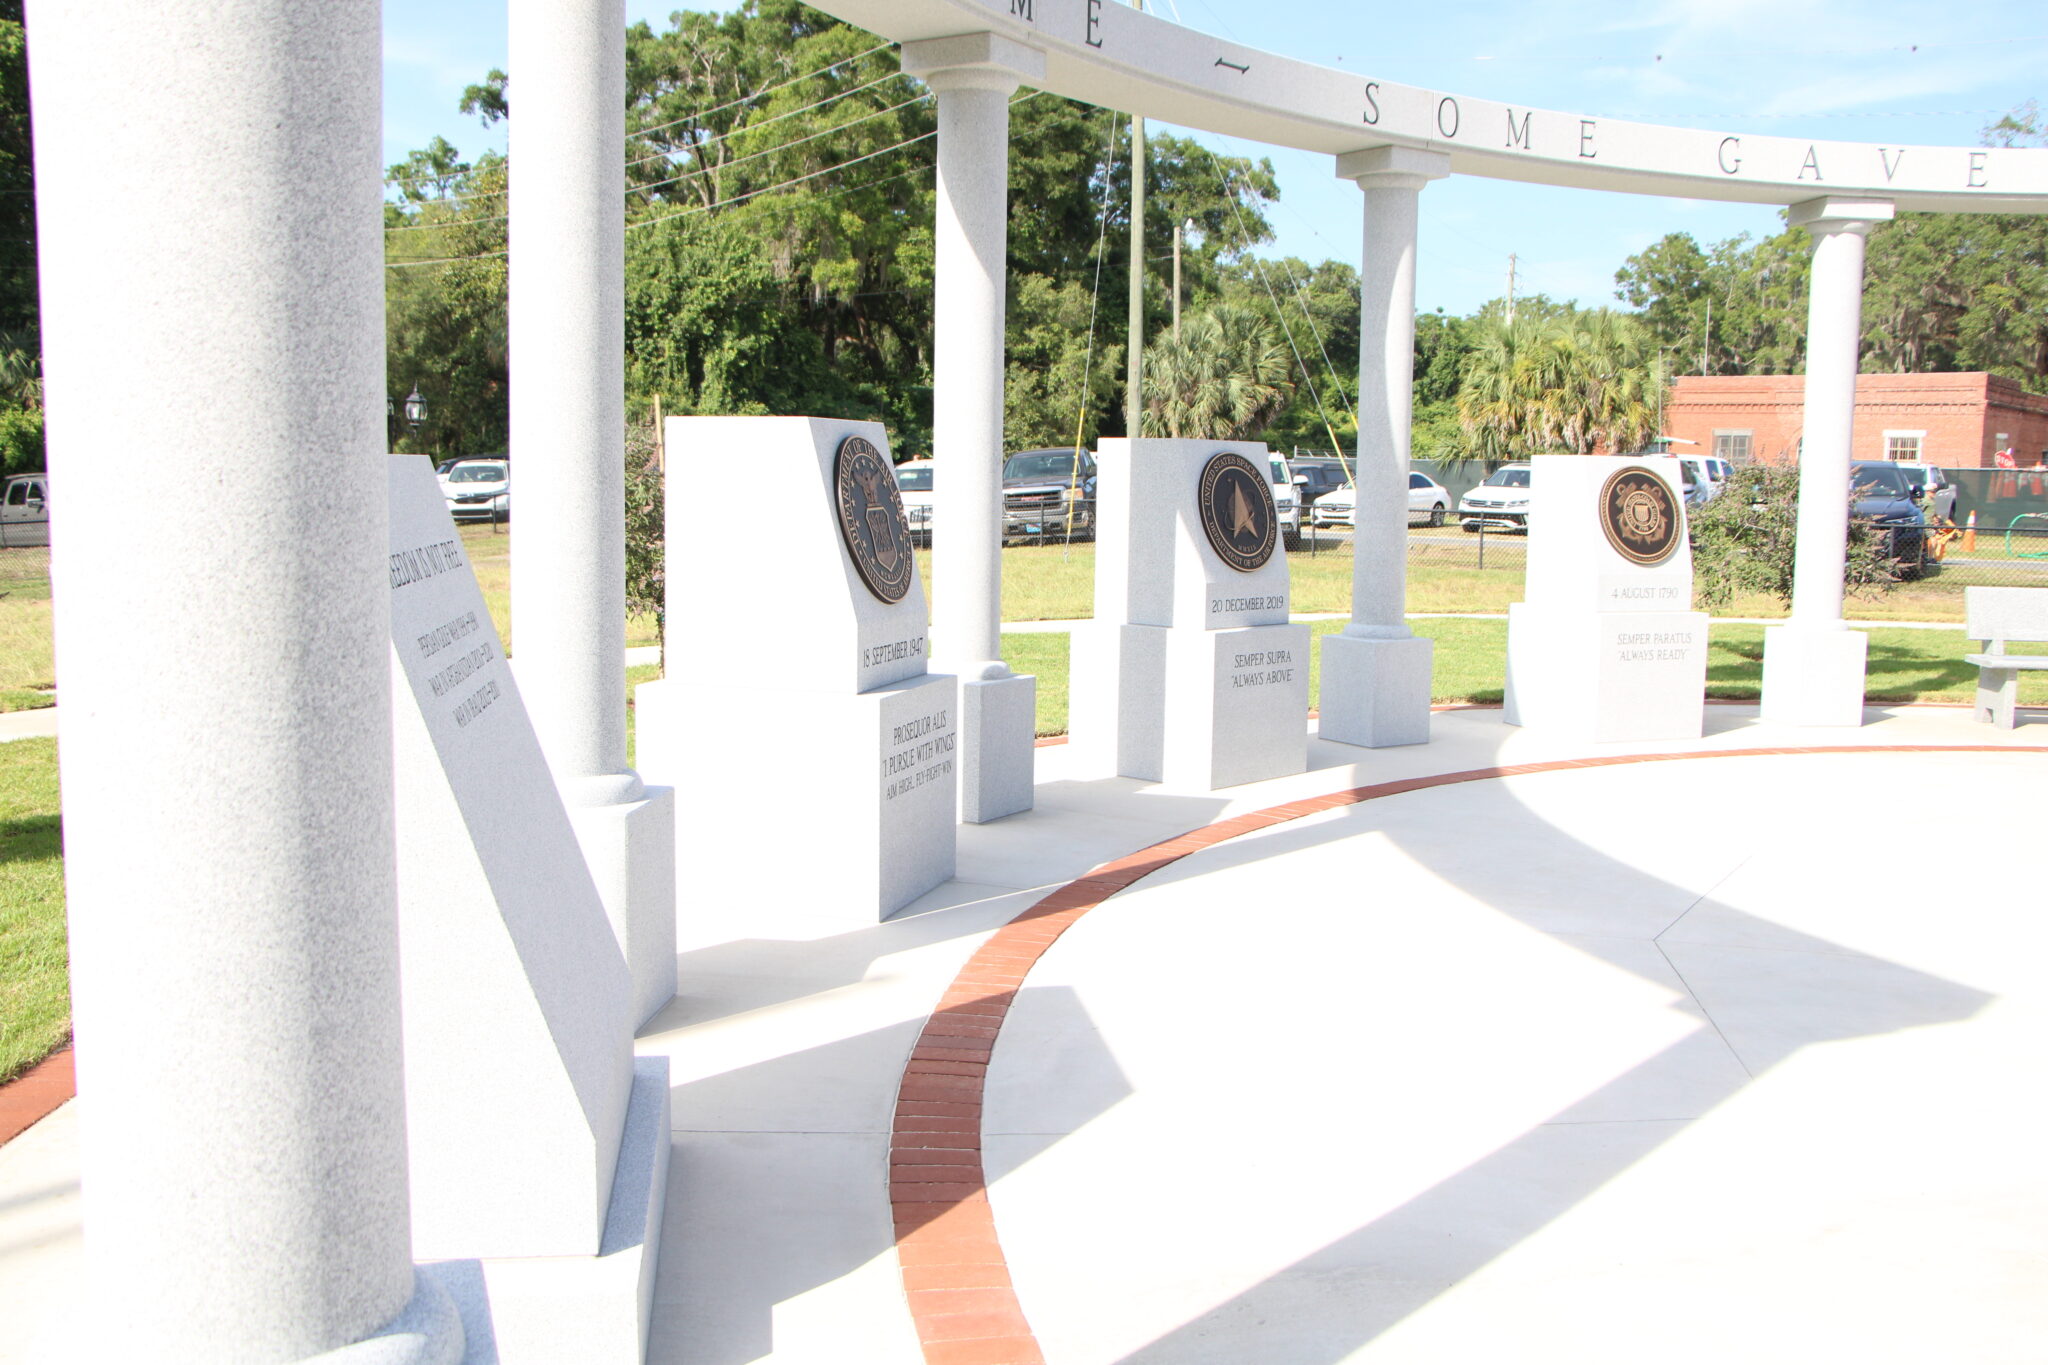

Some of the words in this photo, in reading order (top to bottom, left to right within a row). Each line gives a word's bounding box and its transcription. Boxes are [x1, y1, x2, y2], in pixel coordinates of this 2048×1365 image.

[1363, 81, 1597, 158] SOME
[1718, 136, 1987, 188] GAVE
[841, 446, 859, 546] DEPARTMENT
[853, 440, 863, 454] OF
[863, 441, 880, 461] THE
[880, 462, 894, 485] AIR
[892, 489, 911, 538] FORCE
[1204, 470, 1216, 505] UNITED
[1213, 456, 1237, 470] STATES
[1236, 458, 1257, 480] SPACE
[1256, 476, 1273, 505] FORCE
[415, 547, 431, 579] IS
[425, 543, 446, 576] NOT
[440, 539, 463, 570] FREE
[1210, 521, 1242, 564] DEPARTMENT
[1212, 599, 1223, 613] 20
[1225, 597, 1264, 612] DECEMBER
[1266, 595, 1284, 609] 2019
[1610, 587, 1618, 599] 4
[1620, 587, 1656, 599] AUGUST
[1658, 587, 1679, 599] 1790
[862, 648, 870, 668] 18
[872, 640, 908, 666] SEPTEMBER
[909, 637, 924, 657] 1947
[1617, 632, 1651, 645] SEMPER
[1654, 632, 1692, 644] PARATUS
[1233, 652, 1265, 669] SEMPER
[1266, 650, 1292, 665] SUPRA
[893, 715, 932, 747] PROSEQUOR
[932, 710, 947, 731] ALIS
[889, 748, 915, 776] PURSUE
[916, 740, 933, 763] WITH
[886, 782, 898, 801] AIM
